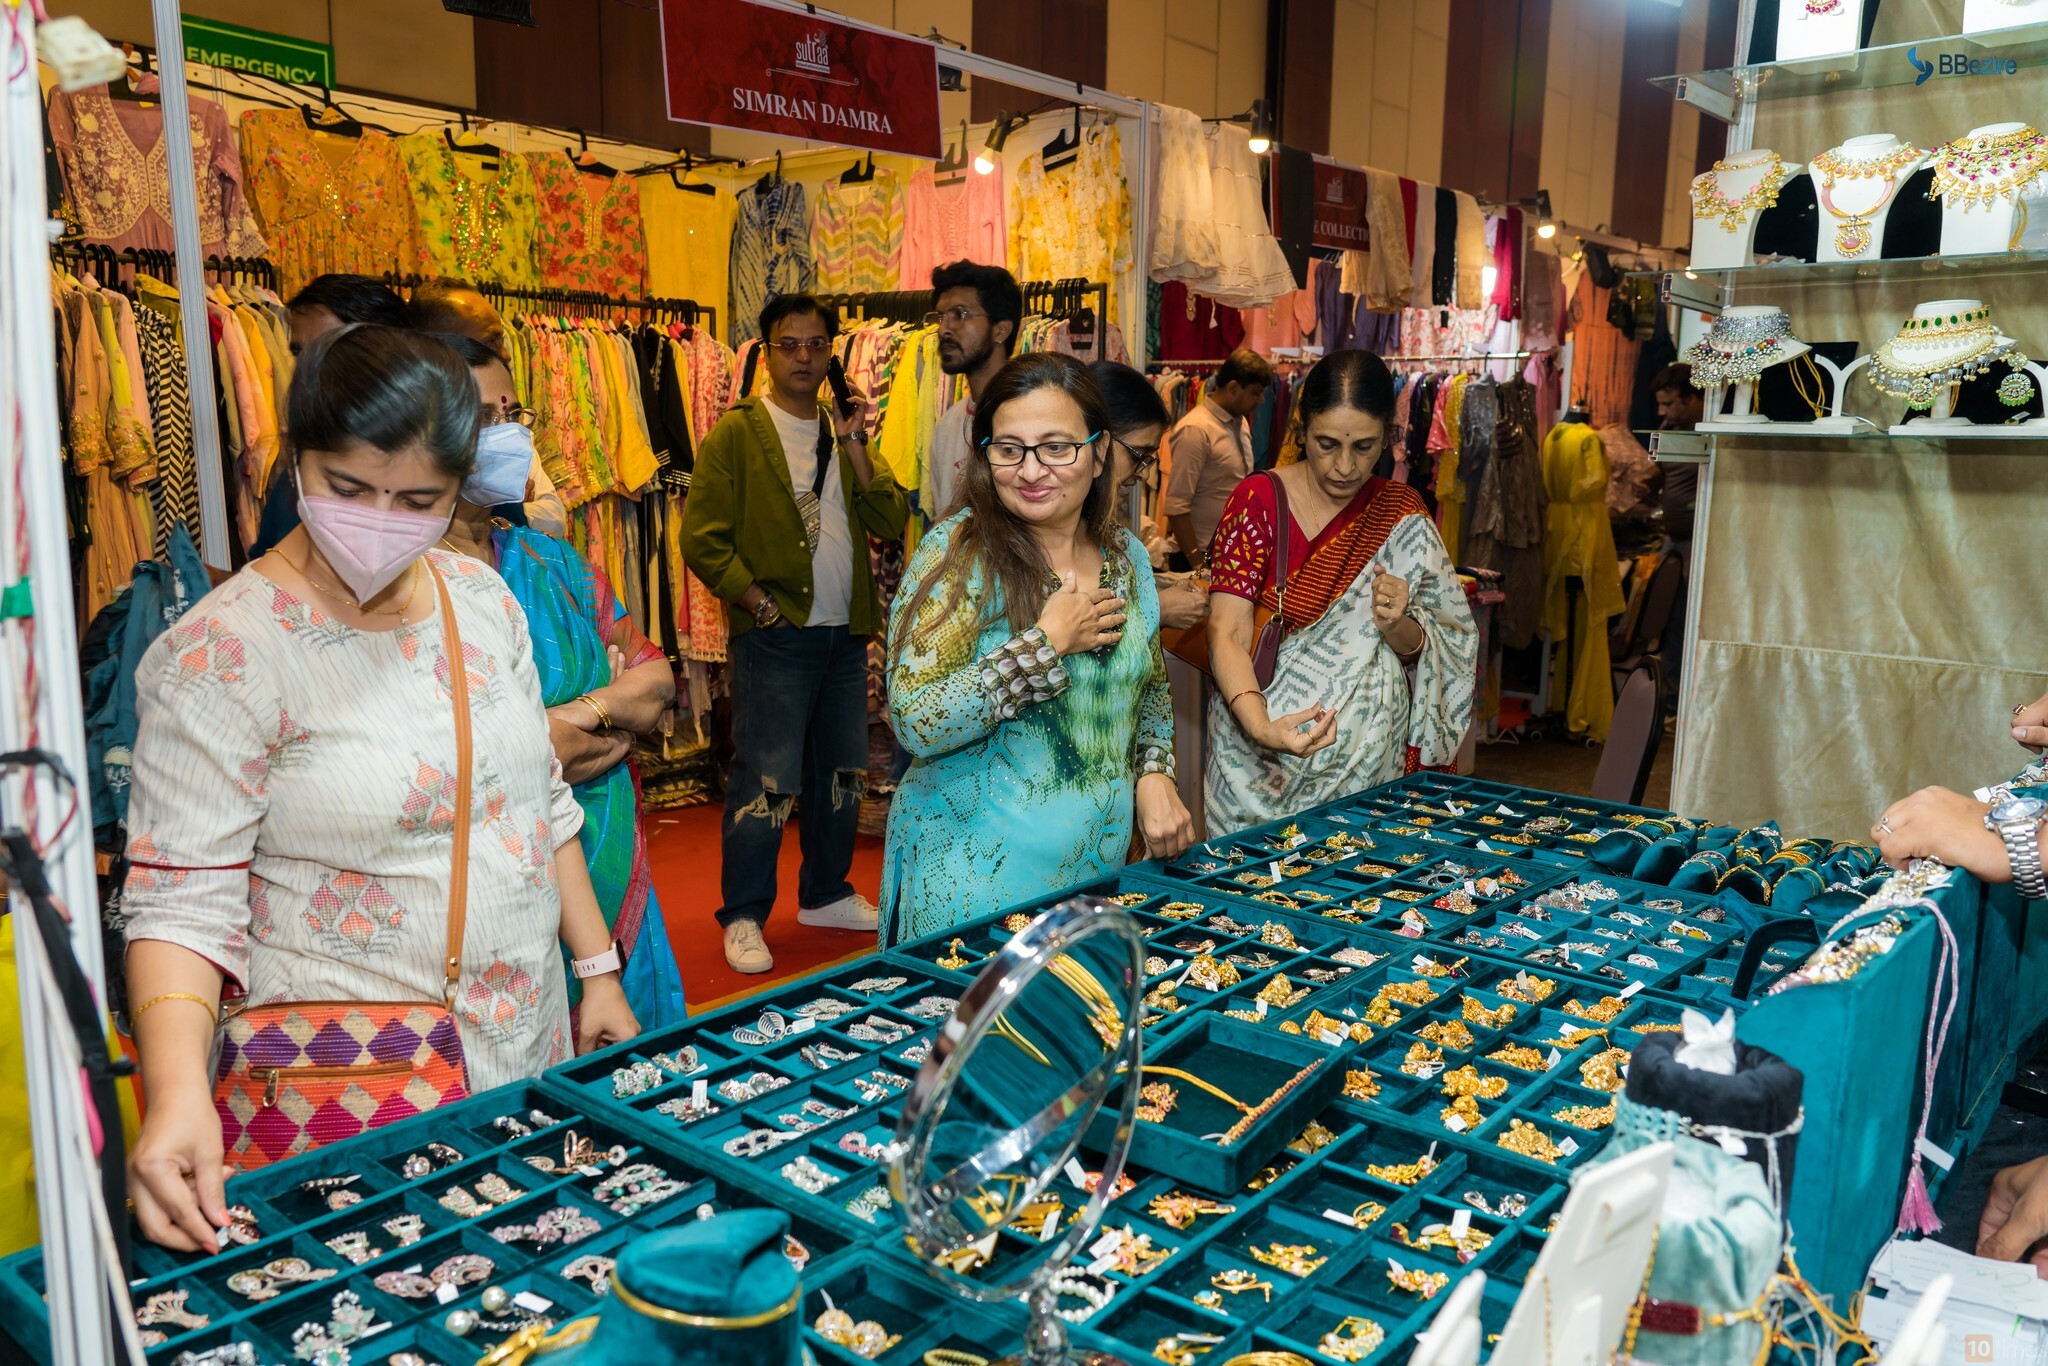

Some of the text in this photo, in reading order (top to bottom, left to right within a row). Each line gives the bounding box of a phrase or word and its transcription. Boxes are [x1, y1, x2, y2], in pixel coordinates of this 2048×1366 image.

[186, 46, 317, 83] EMERGENCY
[795, 34, 829, 65] sutraa
[732, 87, 893, 135] SIMRAN DAMRA
